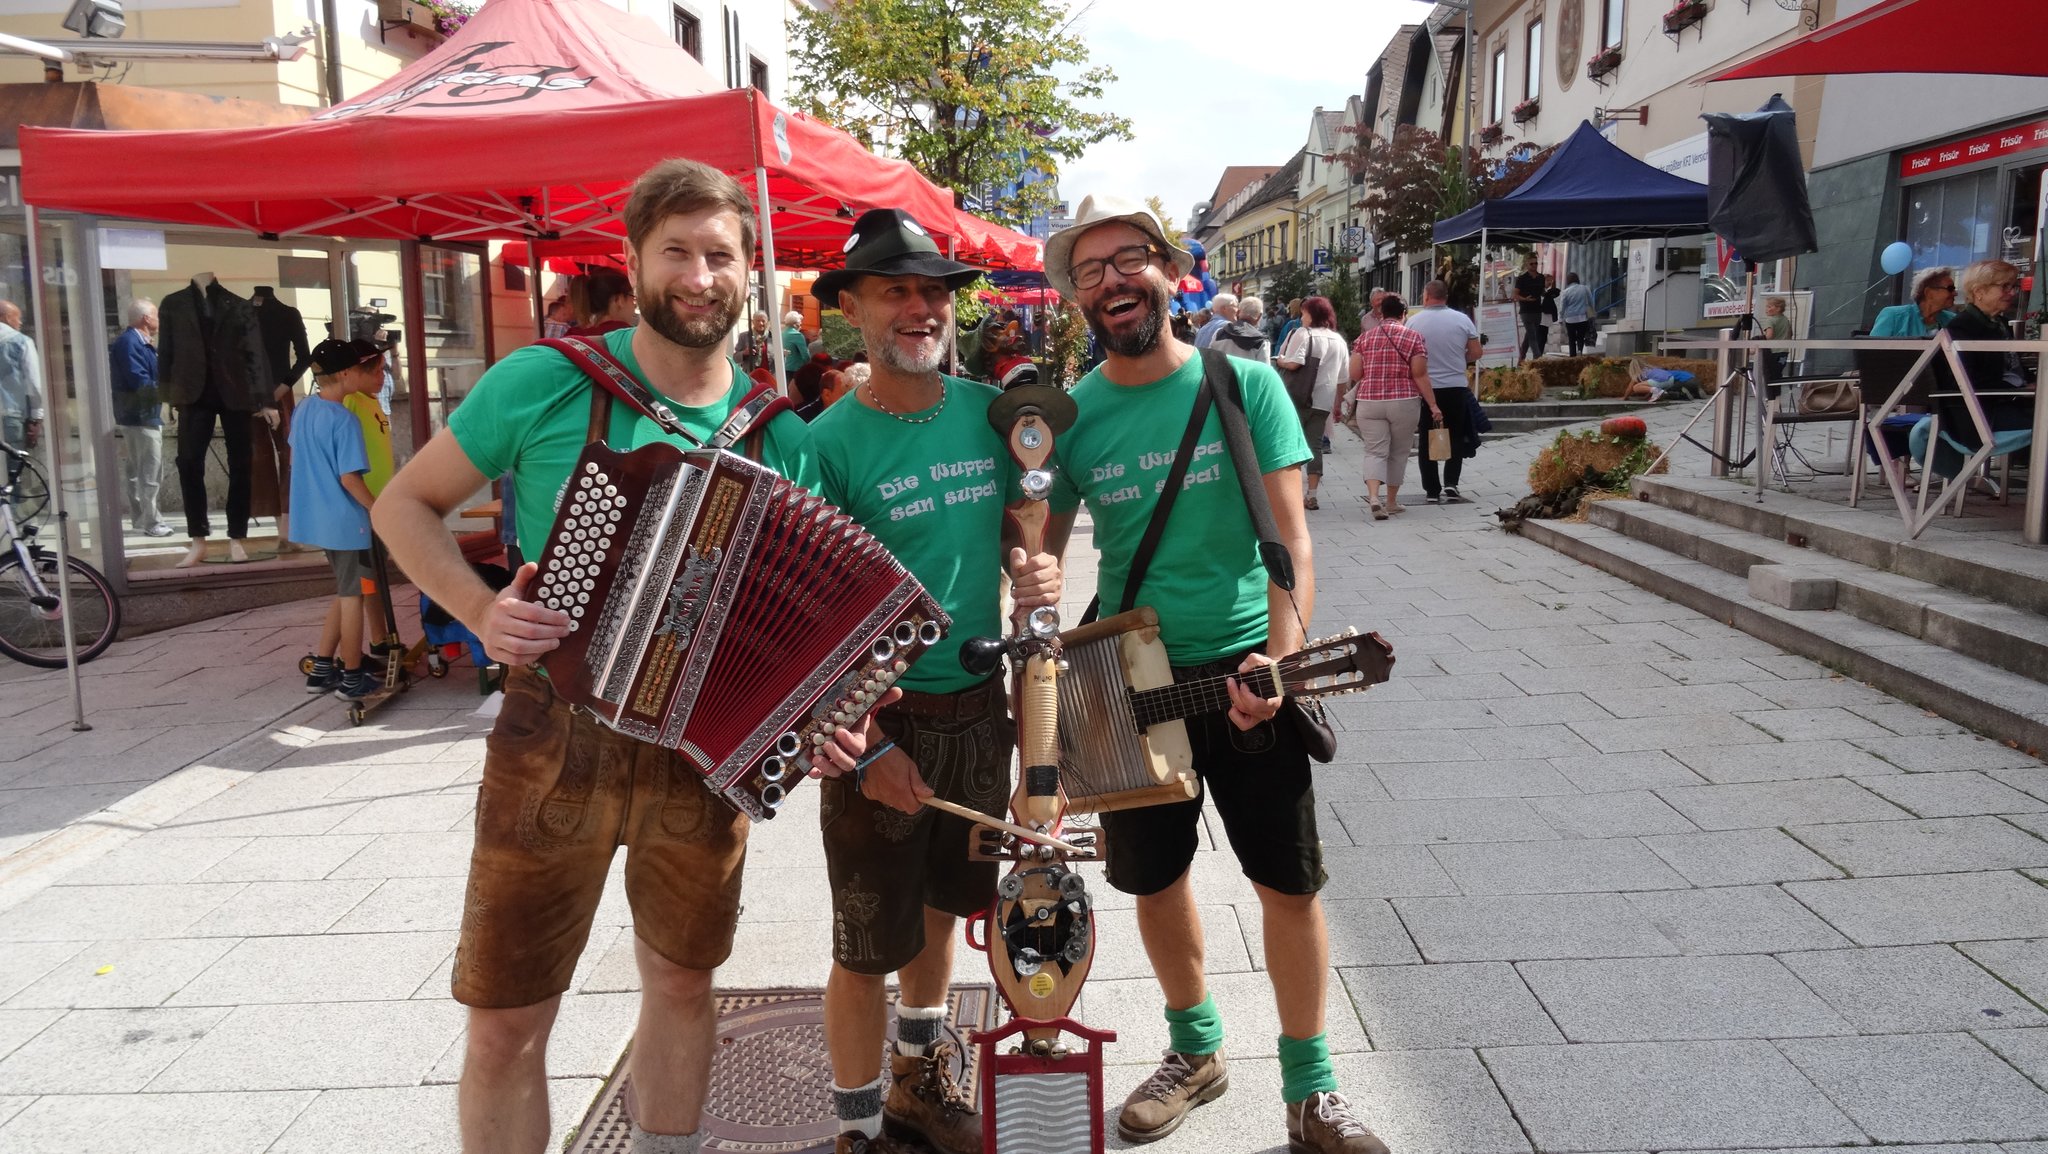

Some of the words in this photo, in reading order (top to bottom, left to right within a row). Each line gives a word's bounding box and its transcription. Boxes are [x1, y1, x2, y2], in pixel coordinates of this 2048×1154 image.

[1912, 157, 1930, 169] Frisör
[1939, 150, 1959, 162] Frisör
[1969, 142, 1990, 155] Frisör
[2000, 135, 2023, 148] Frisör
[877, 475, 919, 500] Die
[929, 457, 996, 481] Wuppa
[1091, 462, 1125, 482] Die
[1138, 440, 1225, 470] Wupa
[890, 497, 936, 521] san
[944, 479, 998, 505] supa!
[1099, 485, 1142, 506] san
[1155, 463, 1221, 490] spa!
